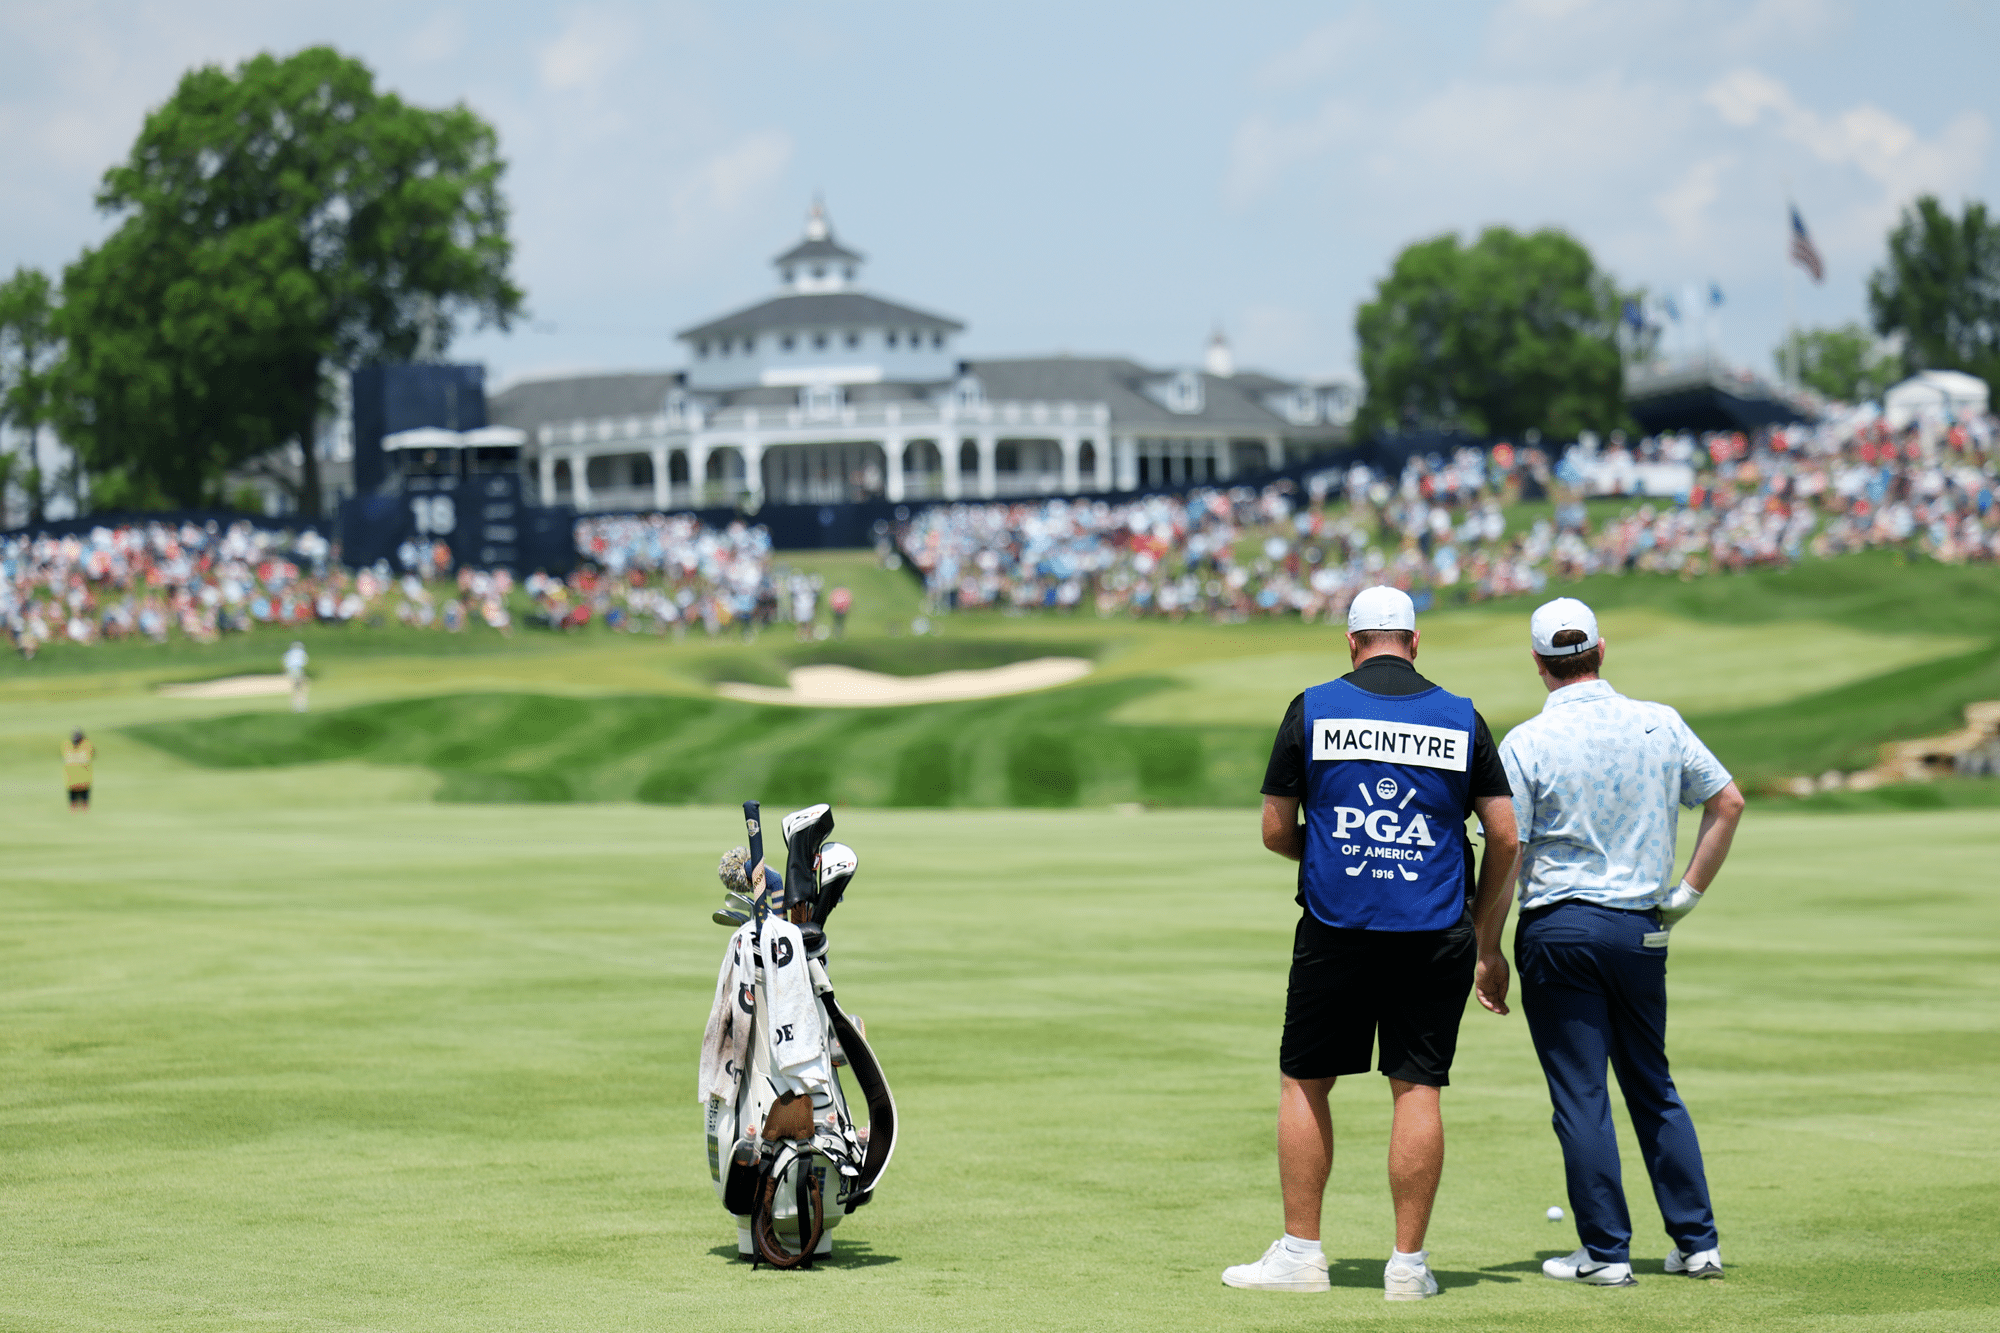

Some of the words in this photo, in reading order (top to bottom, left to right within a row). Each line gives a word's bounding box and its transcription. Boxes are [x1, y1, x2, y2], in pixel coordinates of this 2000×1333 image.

[1324, 729, 1456, 760] MACINTYRE
[1332, 806, 1436, 847] PGA
[1341, 845, 1361, 856] OF
[1364, 846, 1424, 861] AMERICA
[1371, 869, 1394, 880] 1916
